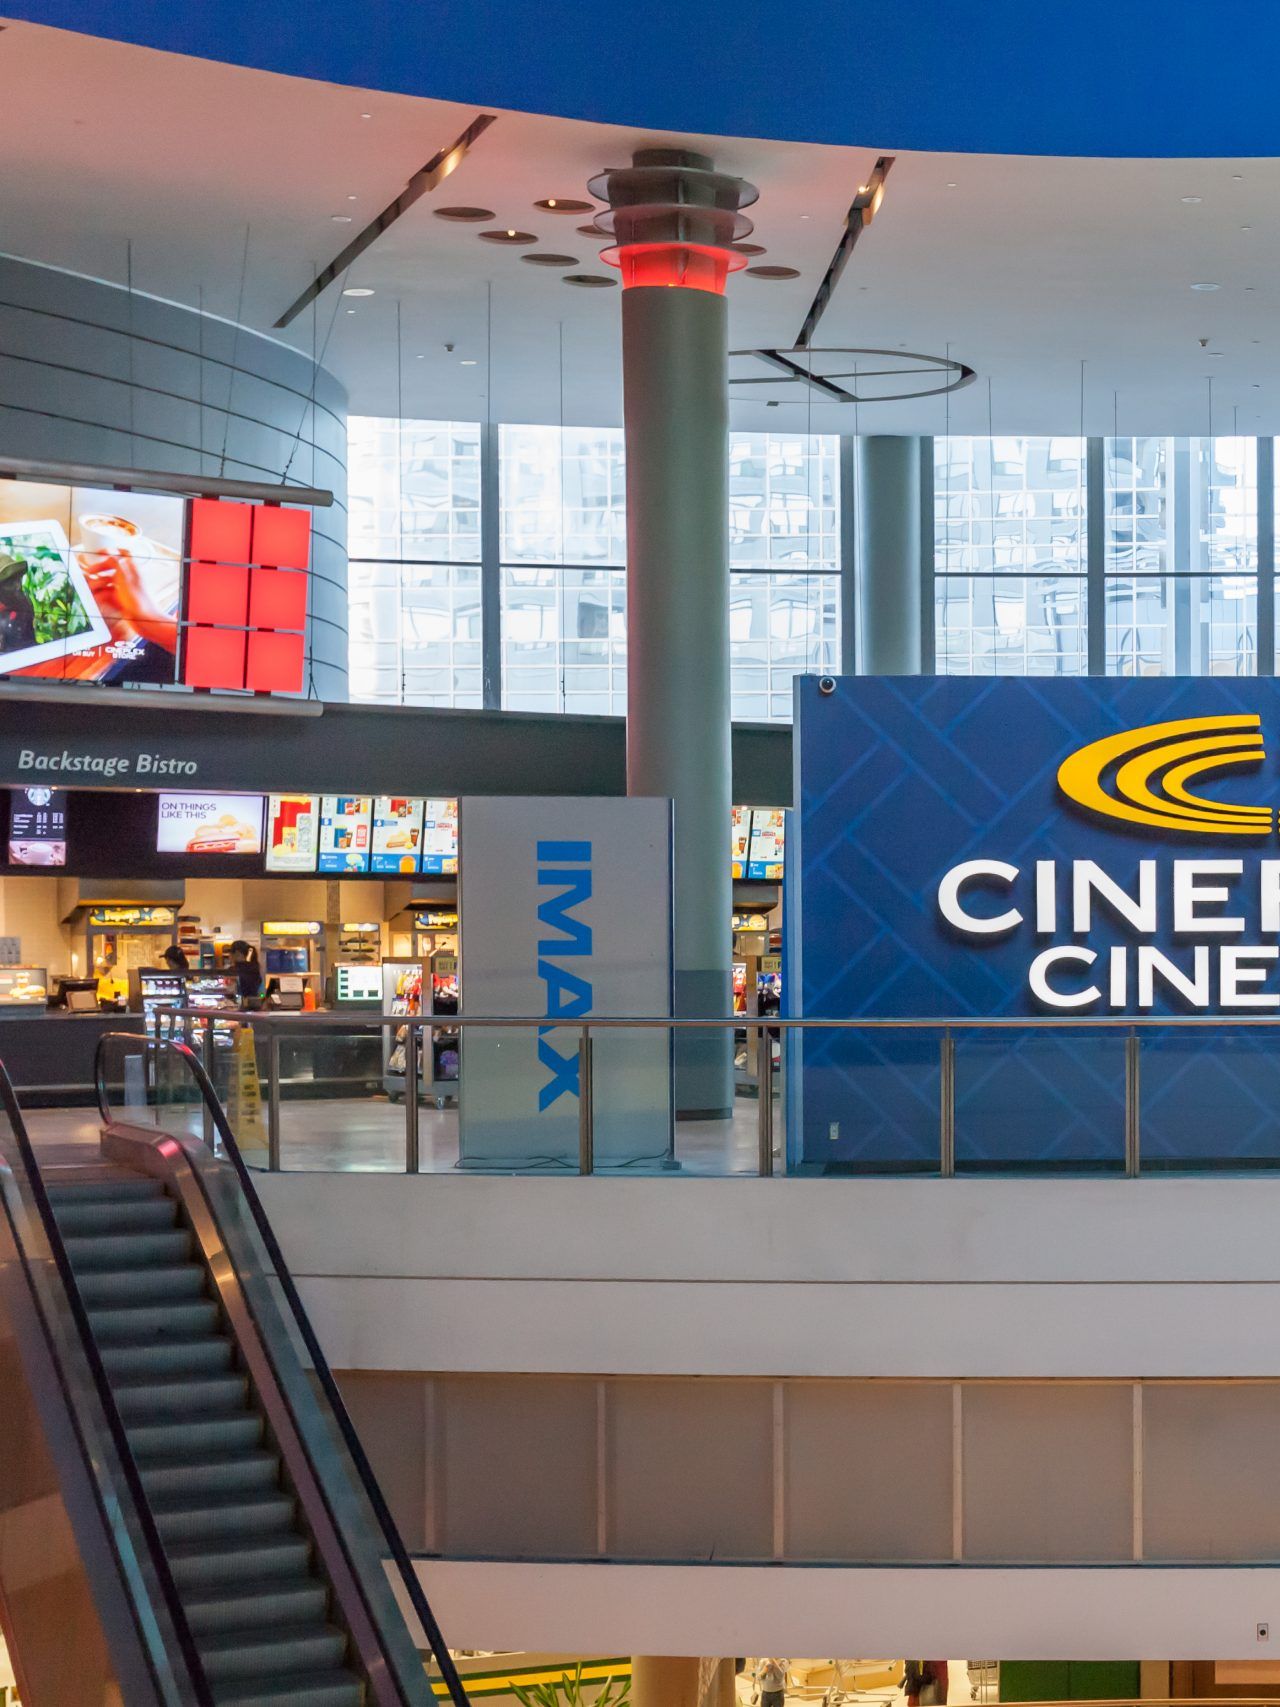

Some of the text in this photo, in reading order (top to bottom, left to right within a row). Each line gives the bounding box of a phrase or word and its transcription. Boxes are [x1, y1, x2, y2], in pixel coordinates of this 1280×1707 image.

[105, 646, 145, 656] CINEPLEX
[18, 750, 197, 777] Backstage Bistro
[161, 802, 216, 811] ON THINGS
[161, 811, 206, 819] LIKE THIS
[537, 841, 593, 1112] IMAX
